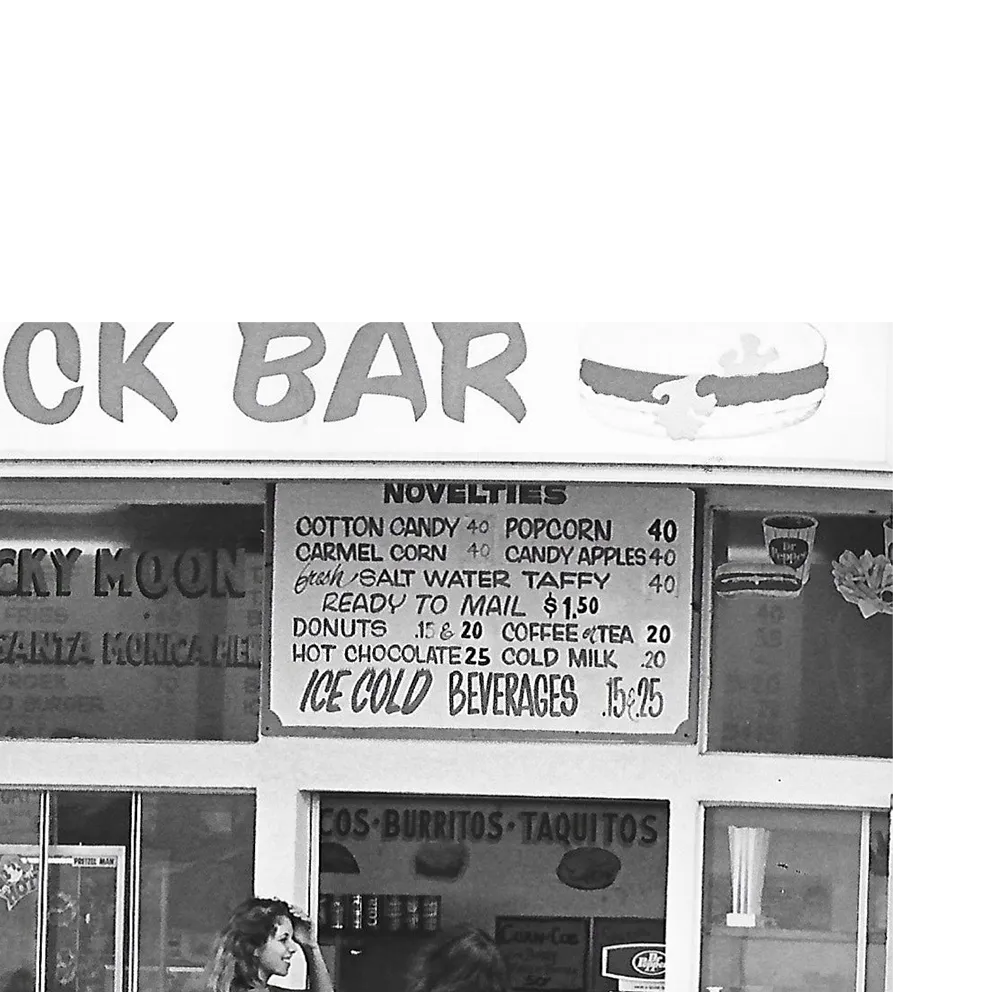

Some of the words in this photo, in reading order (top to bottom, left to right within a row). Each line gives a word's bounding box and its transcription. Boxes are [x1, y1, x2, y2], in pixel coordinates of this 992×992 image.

[232, 320, 527, 424] BAR
[383, 484, 568, 505] NOVELTIES
[296, 516, 384, 537] COTTON
[390, 517, 460, 537] CANDY
[467, 519, 490, 534] 40
[506, 518, 612, 541] POPCORN
[648, 519, 677, 543] 40
[296, 542, 383, 562] CARMEL
[390, 544, 447, 562] CORN
[467, 542, 491, 558] 40
[505, 545, 574, 565] CANDY
[578, 547, 646, 566] APPLES
[649, 549, 676, 566] 40
[93, 548, 246, 599] MOON
[360, 569, 416, 587] SALT
[424, 570, 511, 588] WATER
[522, 571, 611, 590] TAFFY
[649, 574, 676, 593] 40
[322, 592, 407, 614] READY
[416, 594, 448, 615] TO
[461, 594, 526, 616] MAIL
[293, 617, 388, 638] DONUTS
[461, 621, 483, 639] 20
[502, 622, 579, 642] COFFEE
[597, 625, 634, 644] TEA
[647, 625, 671, 643] 20
[102, 631, 203, 667] MONICA
[293, 643, 337, 662] HOT
[344, 644, 462, 665] CHOCOLATE
[465, 647, 491, 666] 25
[502, 647, 559, 667] COLD
[568, 648, 618, 669] MILK
[299, 669, 352, 713] ICE
[351, 668, 433, 715] COLD
[449, 670, 579, 718] BEVERAGES
[383, 808, 504, 842] BURRITOS
[521, 811, 658, 845] TAQUITOS
